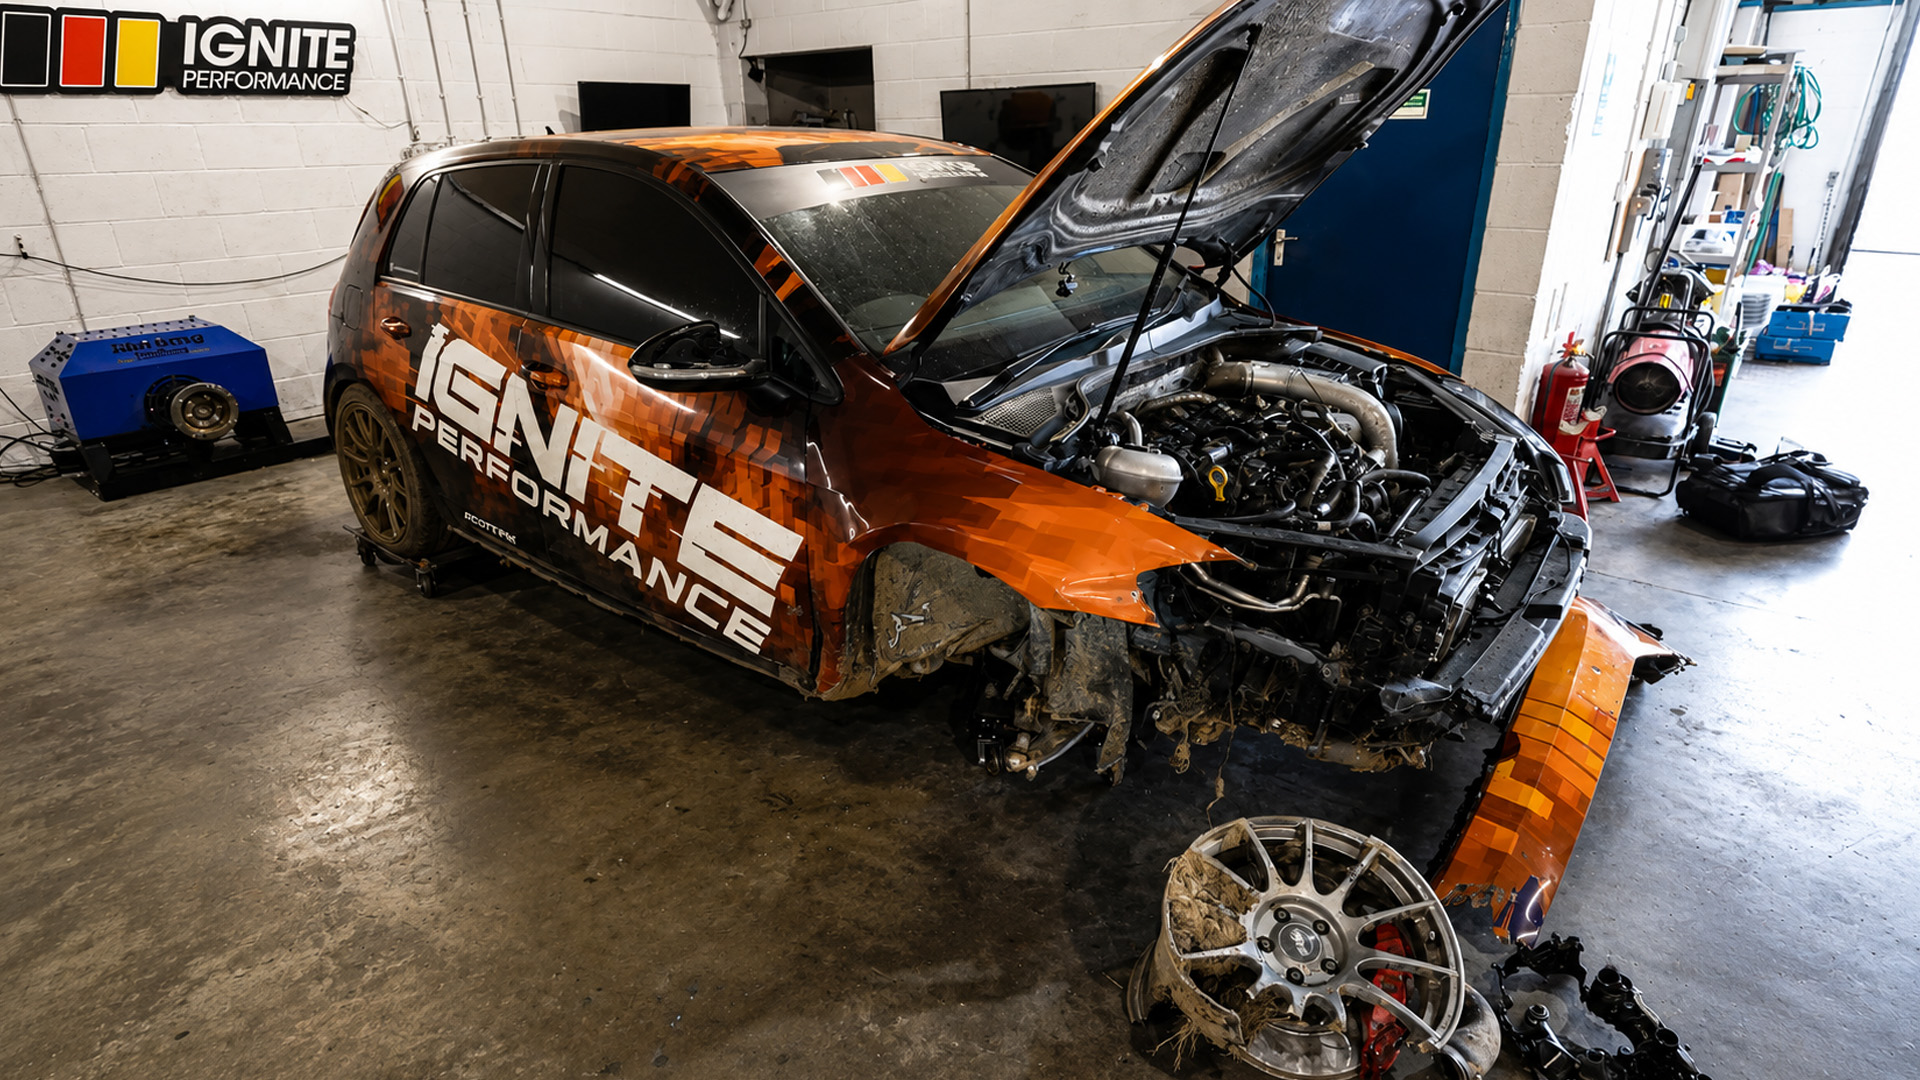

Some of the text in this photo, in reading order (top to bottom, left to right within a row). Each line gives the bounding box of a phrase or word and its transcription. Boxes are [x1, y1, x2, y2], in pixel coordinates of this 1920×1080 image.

[182, 69, 346, 91] PERFORMANCE
[183, 21, 351, 69] IGNITE
[412, 403, 772, 655] PERFORMANCE
[415, 322, 804, 618] IGNITE
